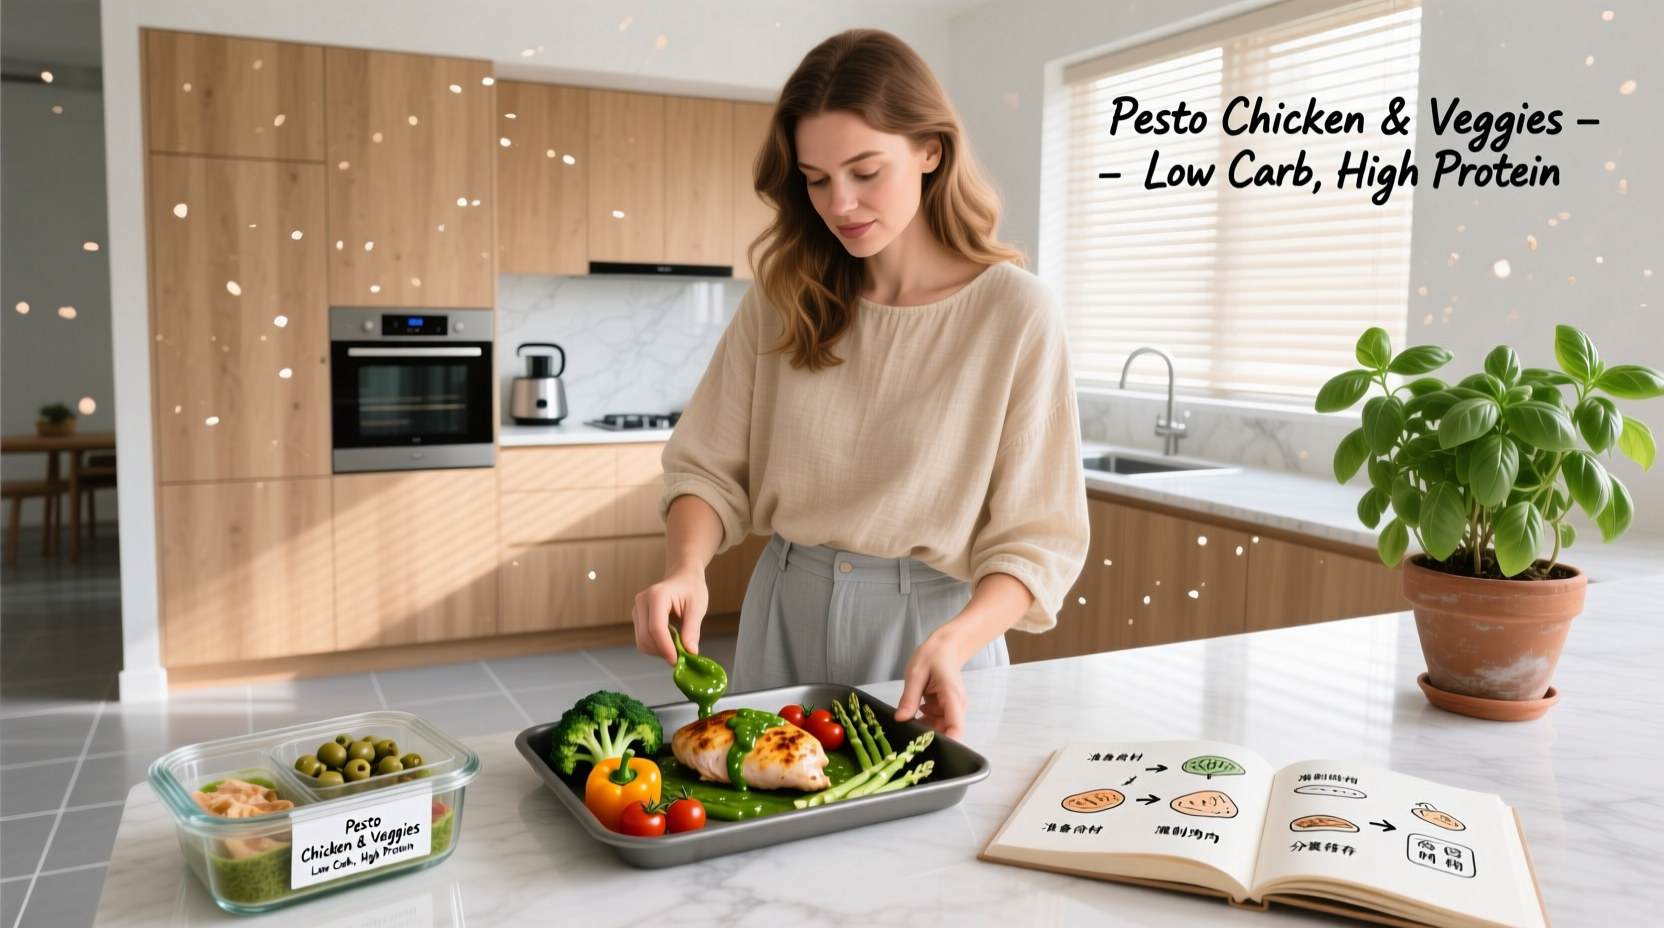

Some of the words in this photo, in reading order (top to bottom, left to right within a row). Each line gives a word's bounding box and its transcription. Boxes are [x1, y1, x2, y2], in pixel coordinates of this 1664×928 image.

[345, 817, 382, 835] Pesto
[301, 841, 353, 863] Chicken
[357, 834, 368, 849] &
